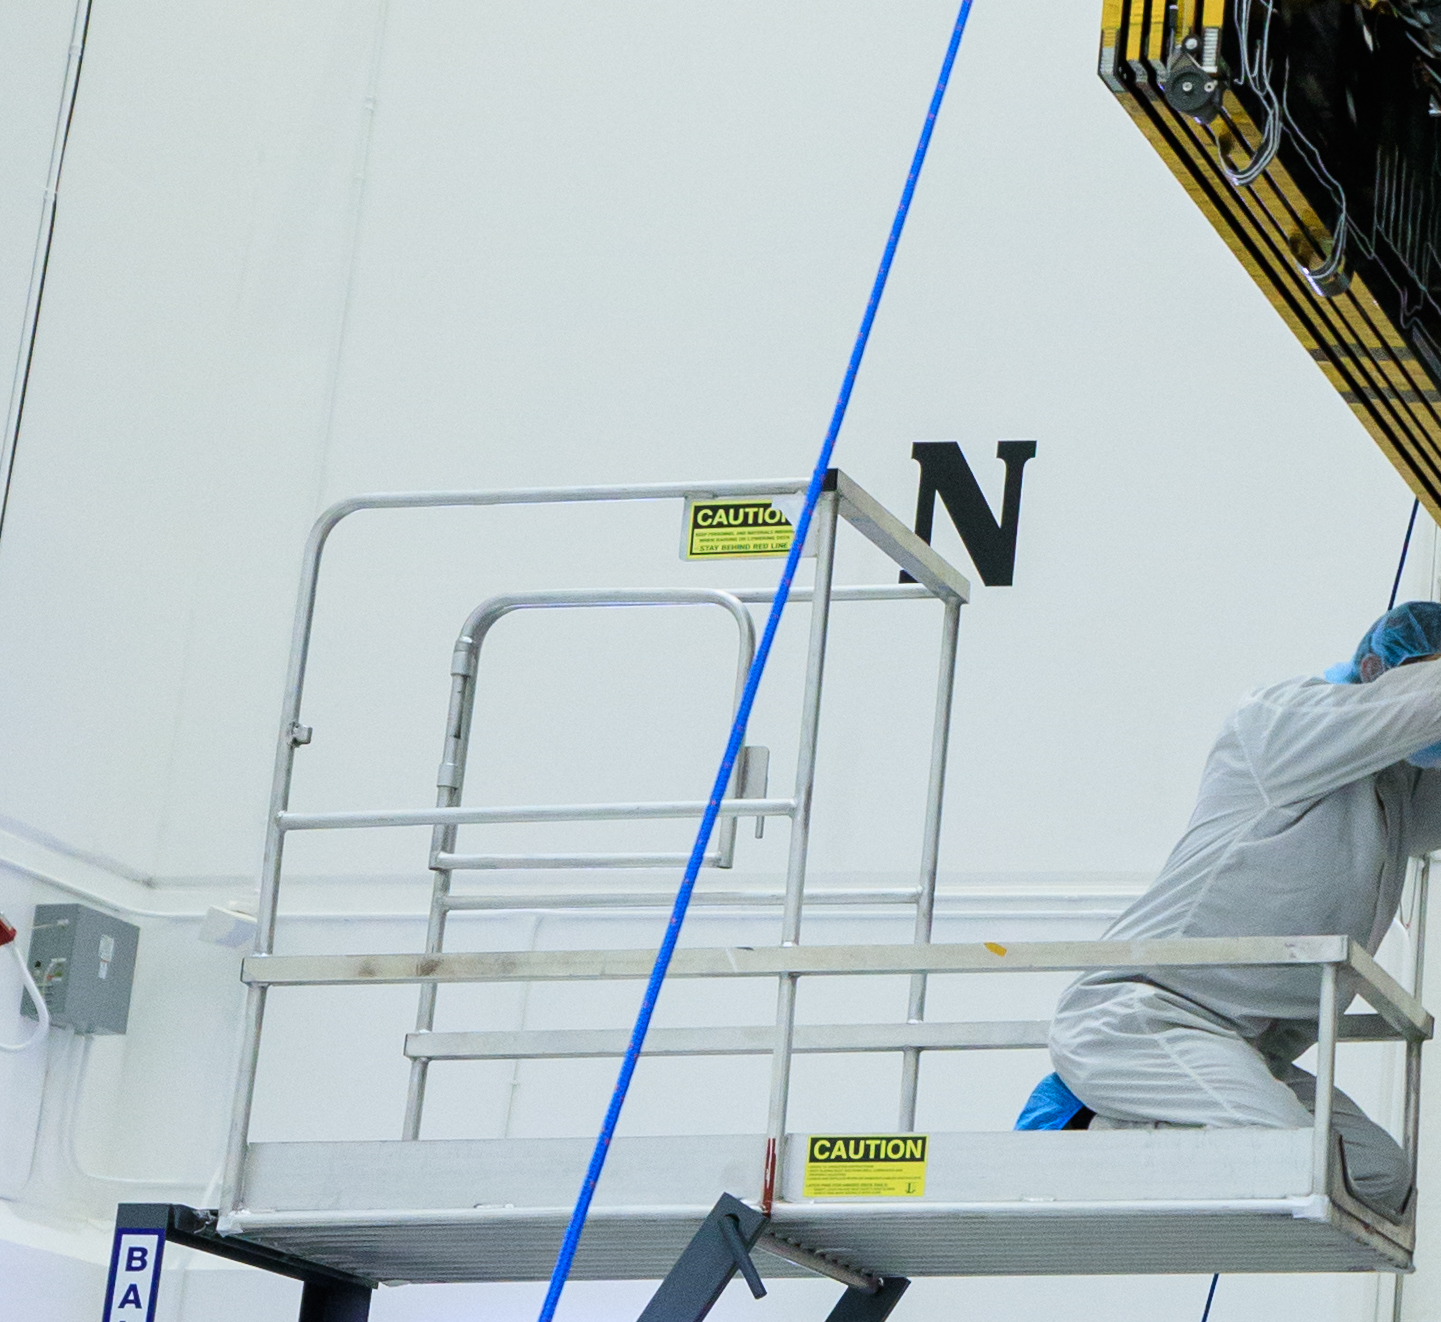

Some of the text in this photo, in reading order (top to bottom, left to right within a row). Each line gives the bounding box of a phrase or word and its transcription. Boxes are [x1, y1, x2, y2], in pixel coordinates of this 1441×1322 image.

[899, 440, 1037, 587] N
[813, 1139, 923, 1160] CAUTION
[118, 1246, 149, 1322] BA
